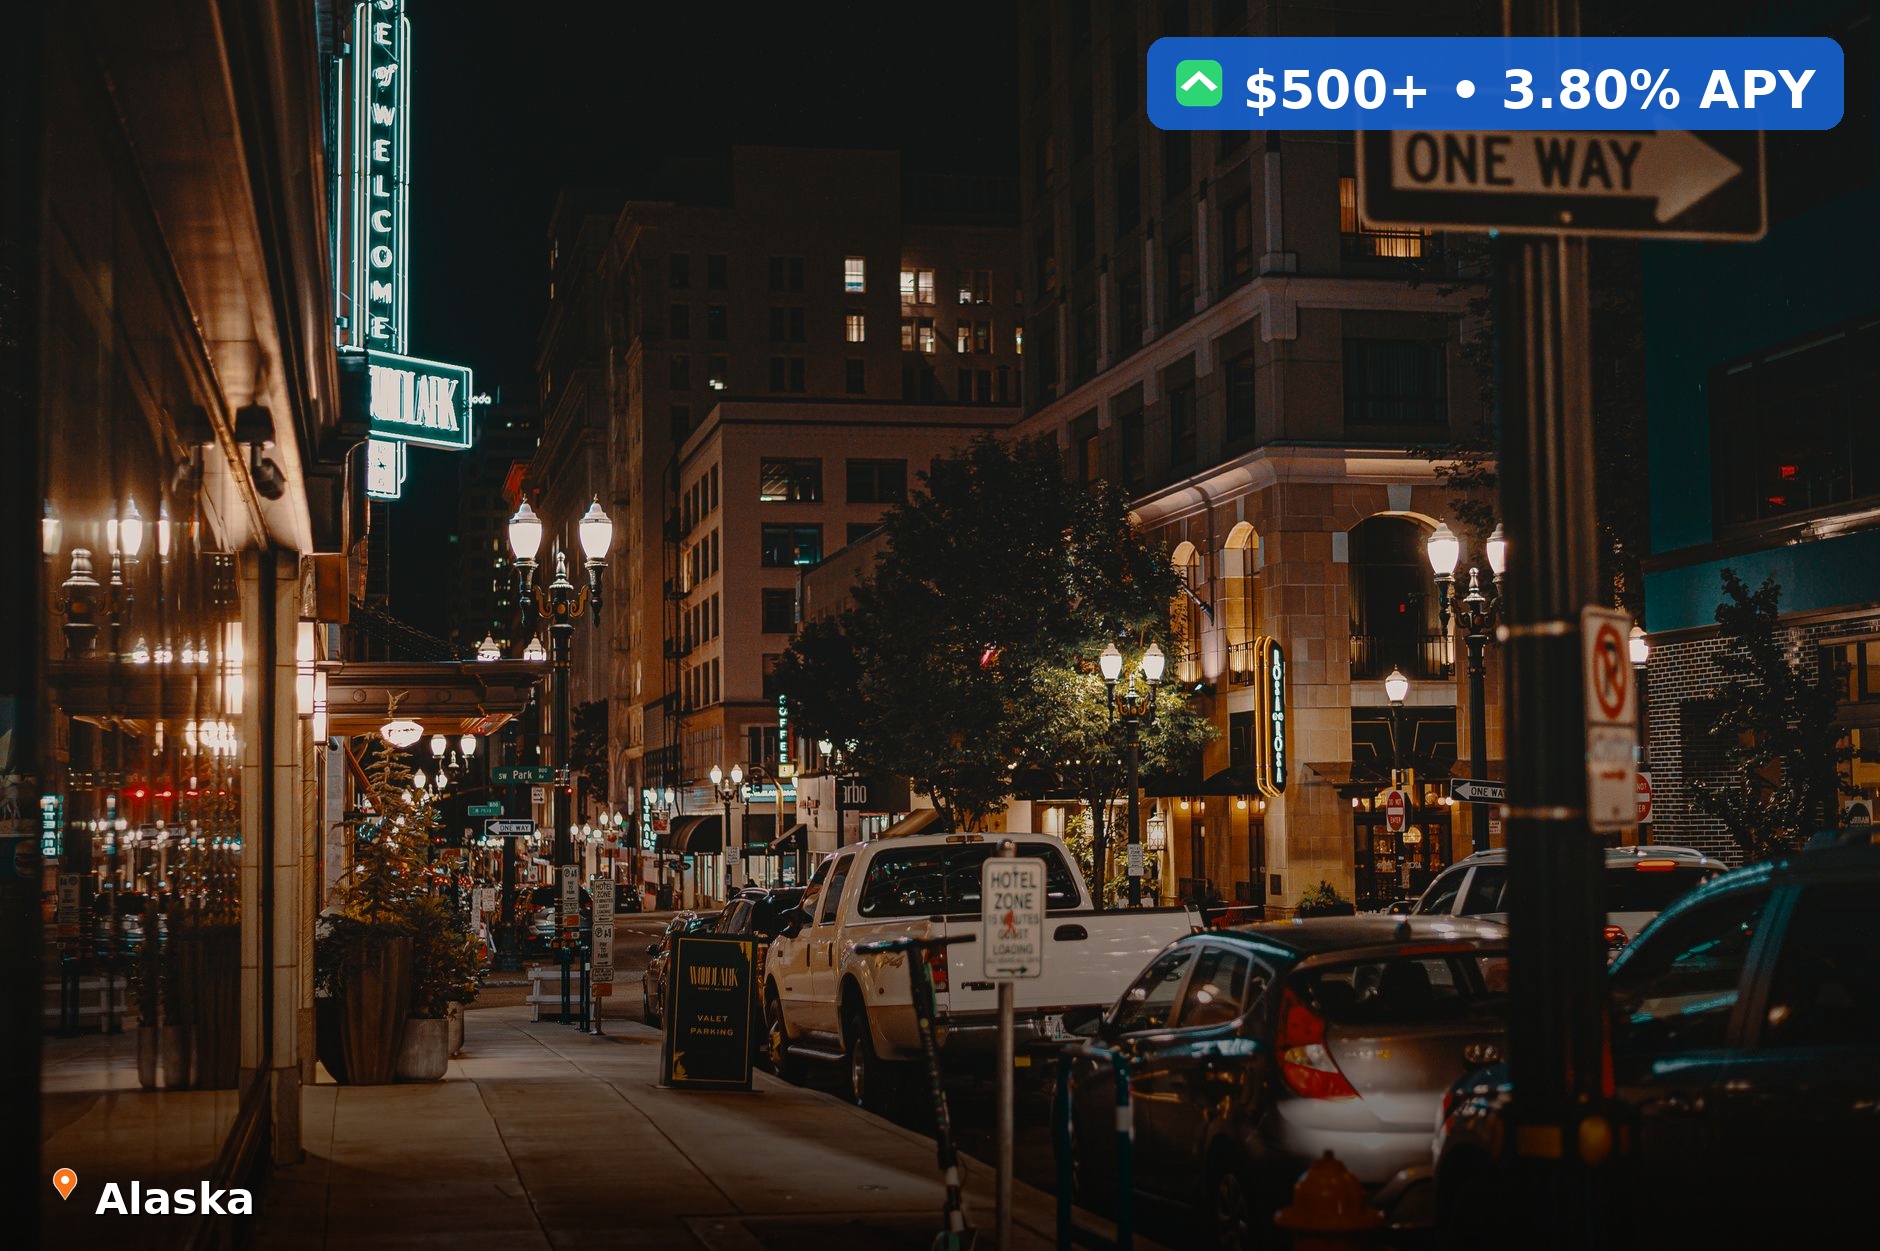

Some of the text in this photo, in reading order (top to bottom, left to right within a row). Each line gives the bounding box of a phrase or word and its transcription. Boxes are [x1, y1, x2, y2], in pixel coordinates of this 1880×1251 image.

[1405, 130, 1642, 191] ONE WAY
[370, 103, 397, 340] WELCOME
[1272, 649, 1282, 712] ROSA
[778, 694, 788, 763] COFFEE
[1273, 721, 1284, 783] ROSA
[512, 769, 533, 780] Park
[1470, 786, 1488, 797] ONE
[1636, 783, 1647, 791] NOT
[1390, 816, 1401, 824] ENTER
[500, 824, 512, 832] ONE
[643, 823, 651, 848] AID
[991, 872, 1037, 889] HOTEL
[595, 883, 613, 891] HOTEL
[994, 893, 1033, 910] ZONE
[992, 944, 1033, 956] LOADING
[697, 1014, 729, 1023] VALET
[690, 1027, 734, 1036] PARKING
